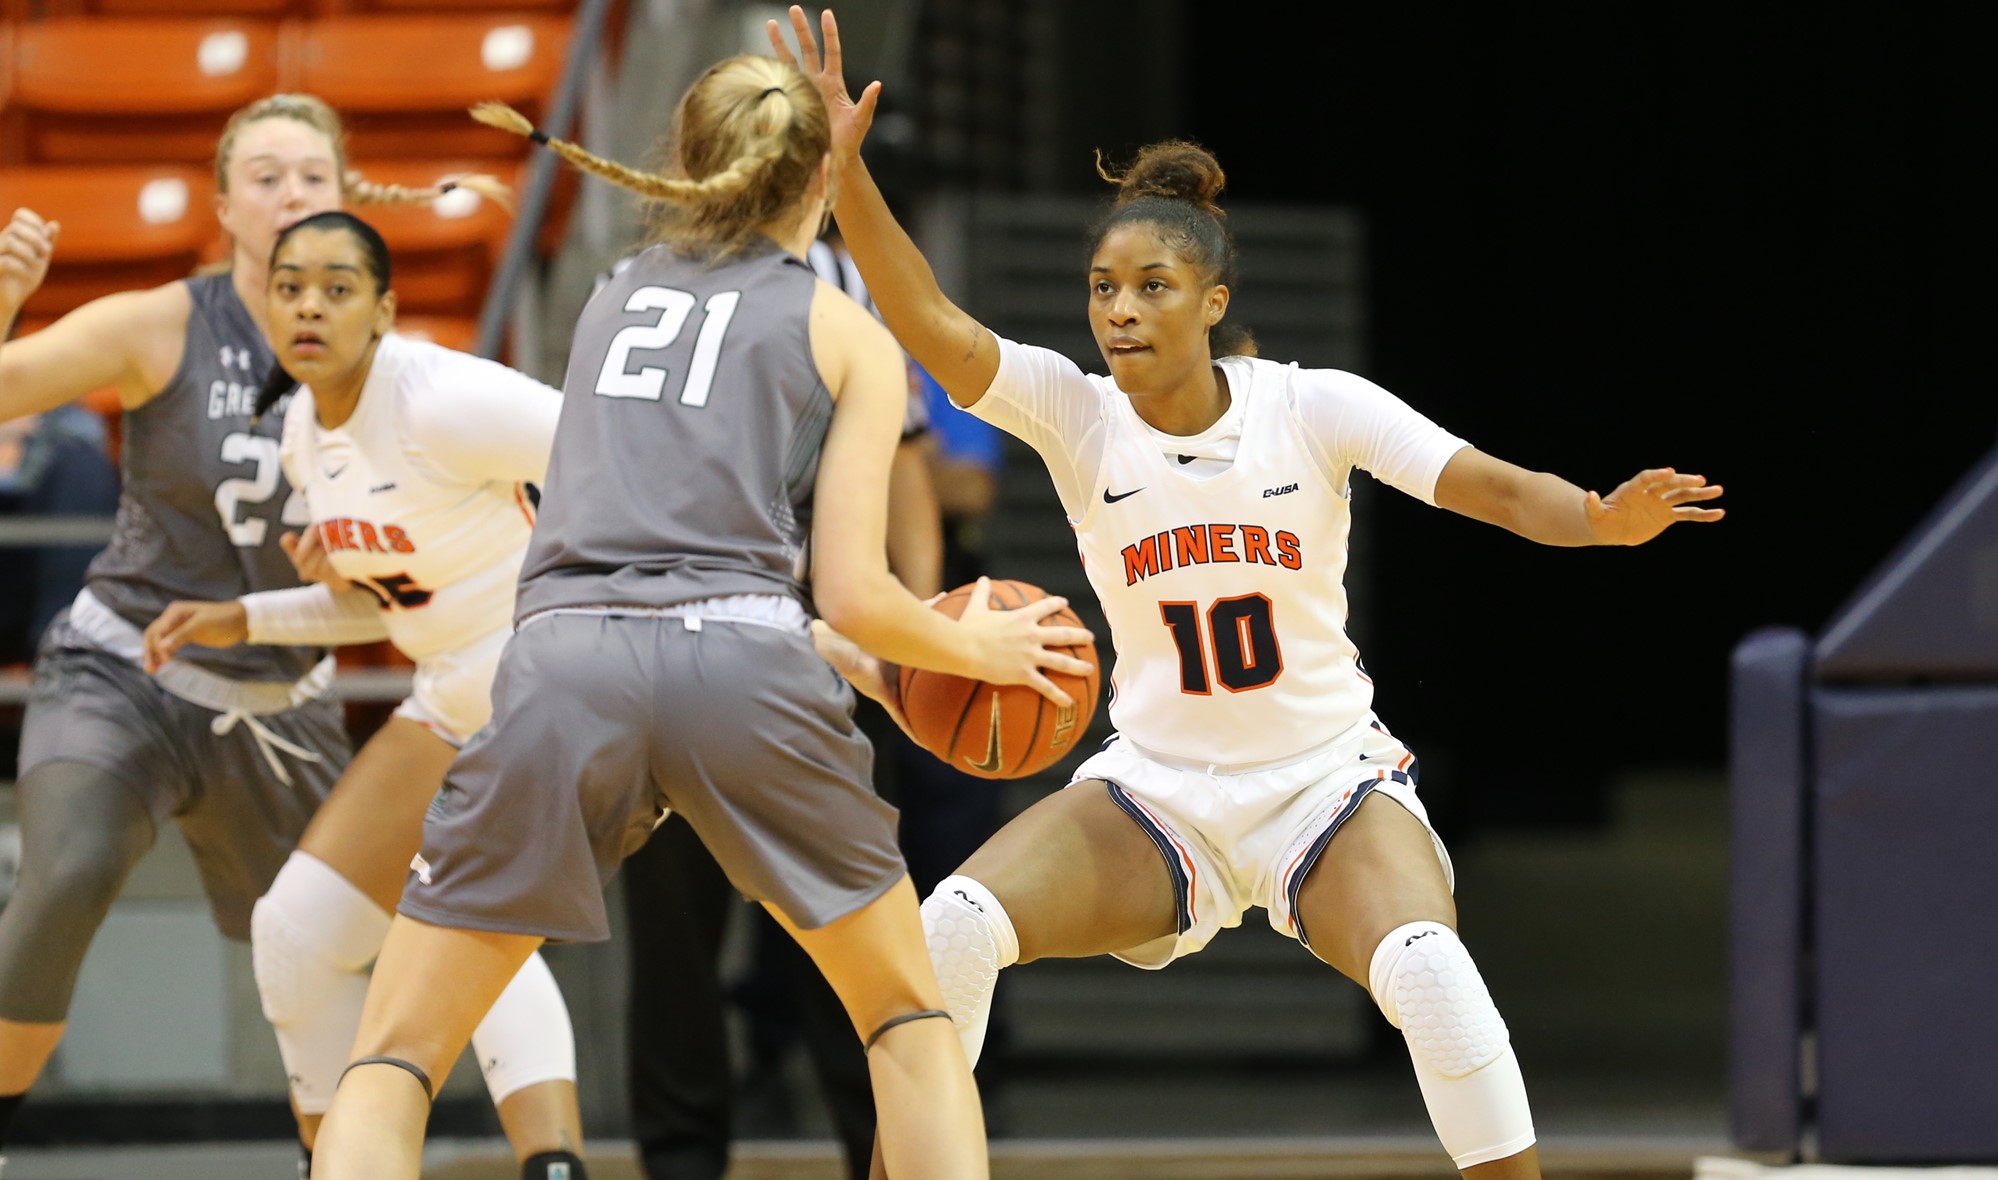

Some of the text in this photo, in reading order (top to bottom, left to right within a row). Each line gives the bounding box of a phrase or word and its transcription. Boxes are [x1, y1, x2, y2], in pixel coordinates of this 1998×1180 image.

[594, 285, 742, 408] 21
[1121, 524, 1302, 587] MINERS
[1158, 591, 1284, 696] 10
